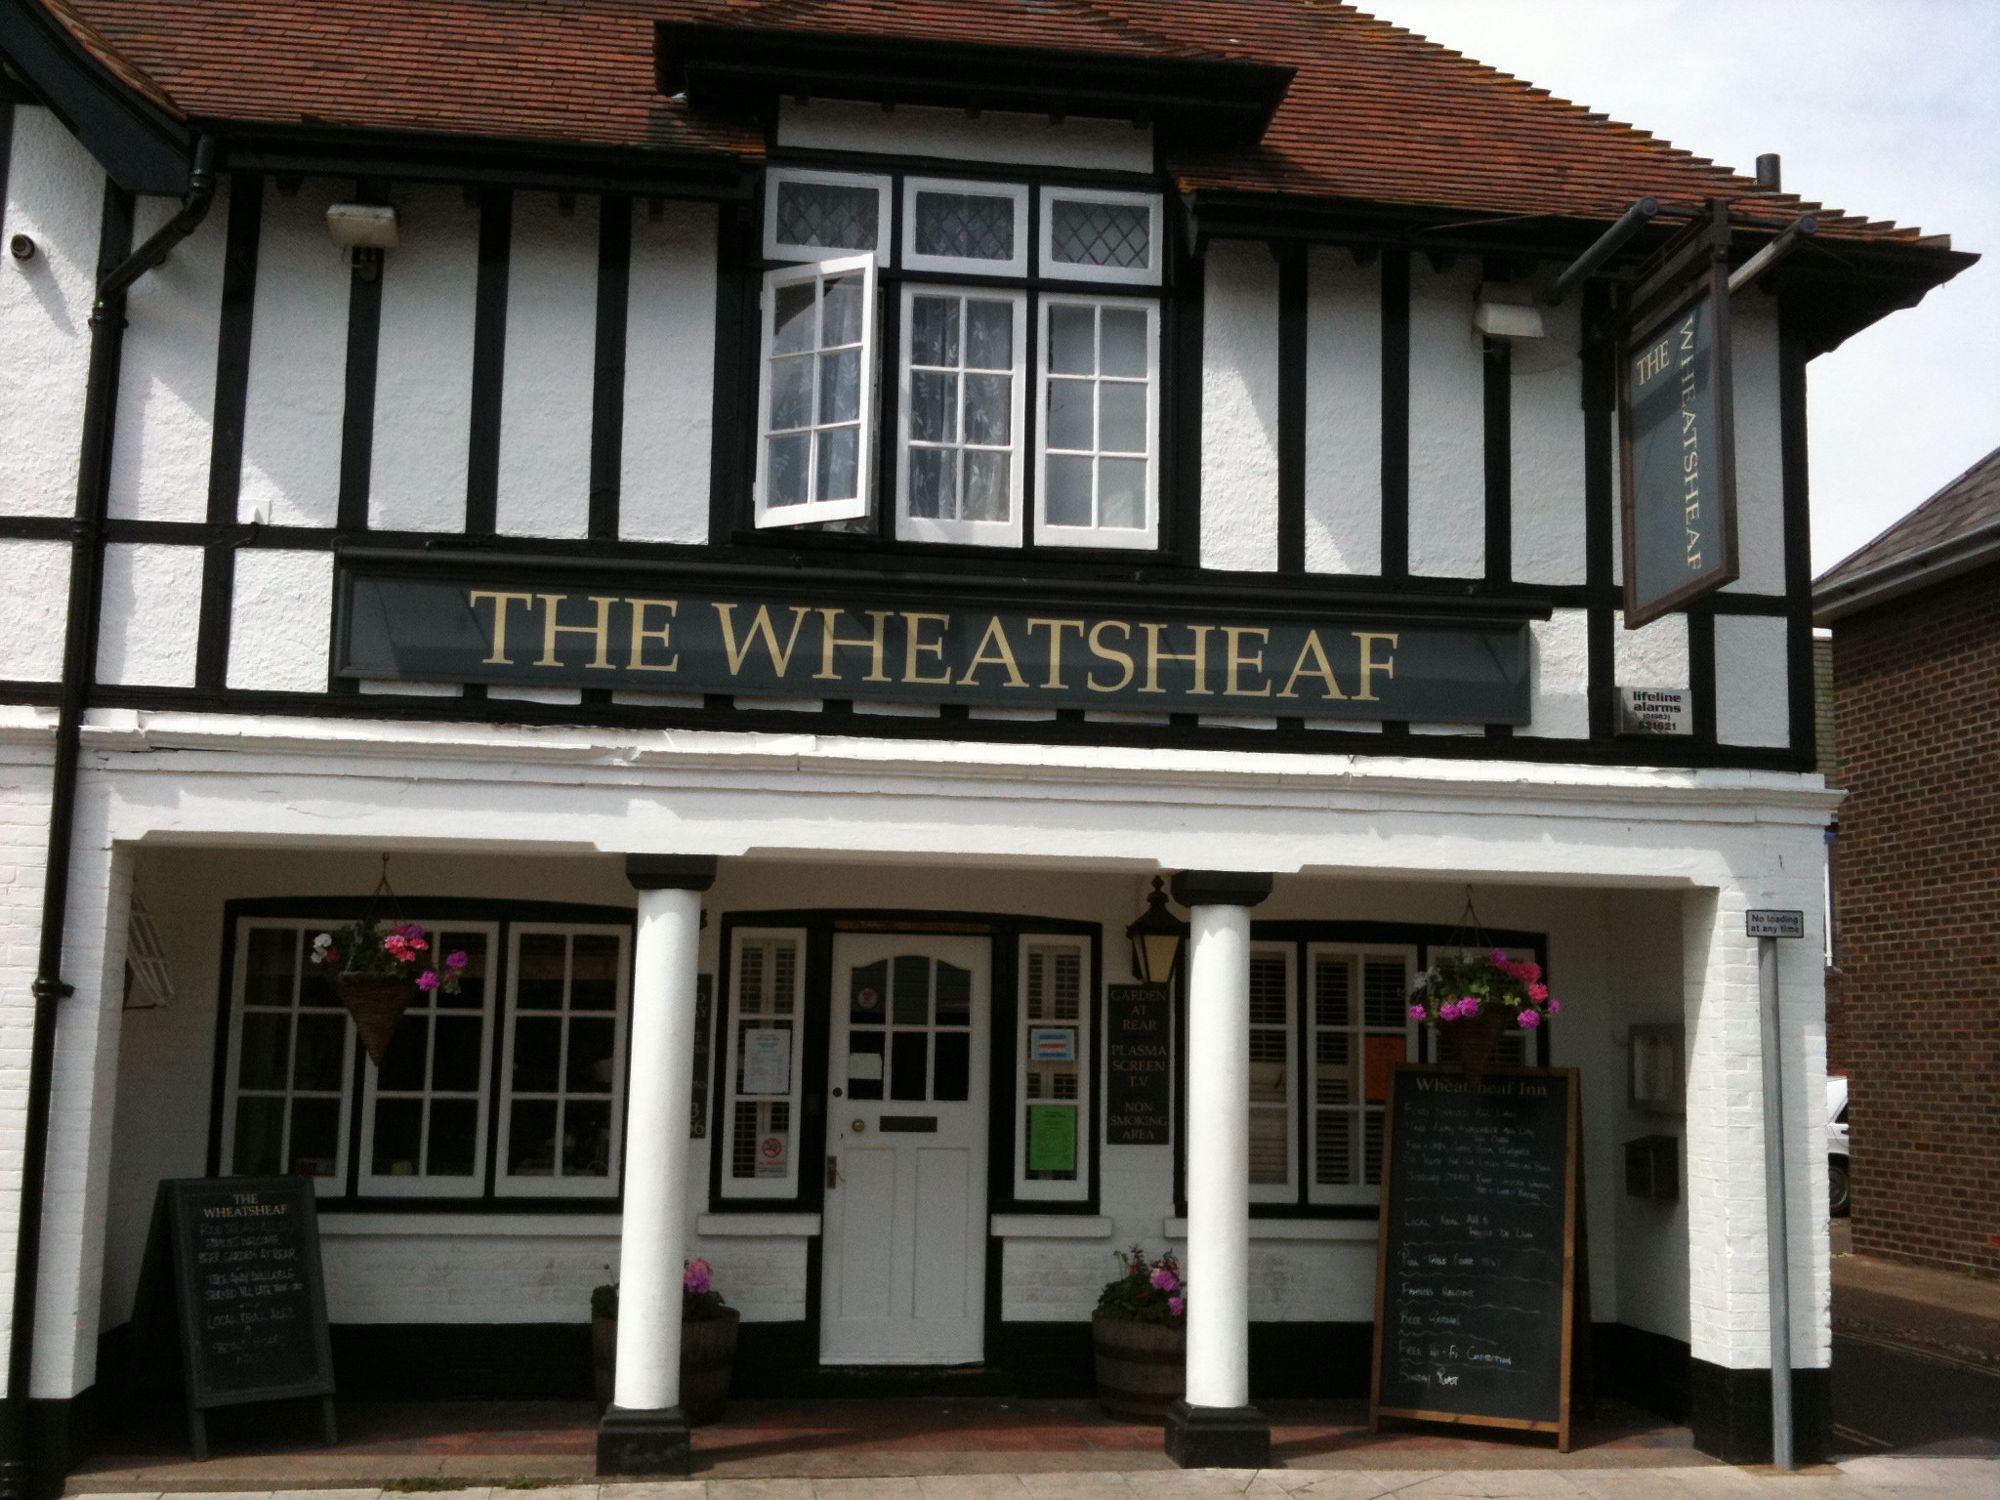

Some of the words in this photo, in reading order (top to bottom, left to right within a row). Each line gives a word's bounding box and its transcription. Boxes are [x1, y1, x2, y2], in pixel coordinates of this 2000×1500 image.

[1636, 338, 1670, 386] THE
[1679, 316, 1703, 571] WHEATSHEAF
[469, 589, 679, 673] THE
[710, 602, 1400, 702] WHEATSHEAF
[1633, 690, 1682, 703] lifeline
[1633, 702, 1682, 713] alarms
[1751, 914, 1765, 923] No
[1766, 914, 1799, 925] loading
[1750, 925, 1760, 933] at
[1762, 926, 1778, 934] any
[1780, 925, 1799, 933] time
[1110, 989, 1167, 1001] GARDEN
[1131, 1004, 1148, 1016] AT
[1122, 1018, 1157, 1031] REAR
[1111, 1044, 1167, 1057] PLASMA
[1112, 1060, 1166, 1072] SCREEN
[1416, 1077, 1512, 1096] Wheatheaf
[1519, 1082, 1548, 1097] Inn
[1124, 1101, 1153, 1112] NON
[1110, 1114, 1168, 1127] SMOKING
[1122, 1128, 1155, 1140] AREA
[233, 1192, 259, 1206] THE
[203, 1203, 289, 1219] WHEATSHEAF
